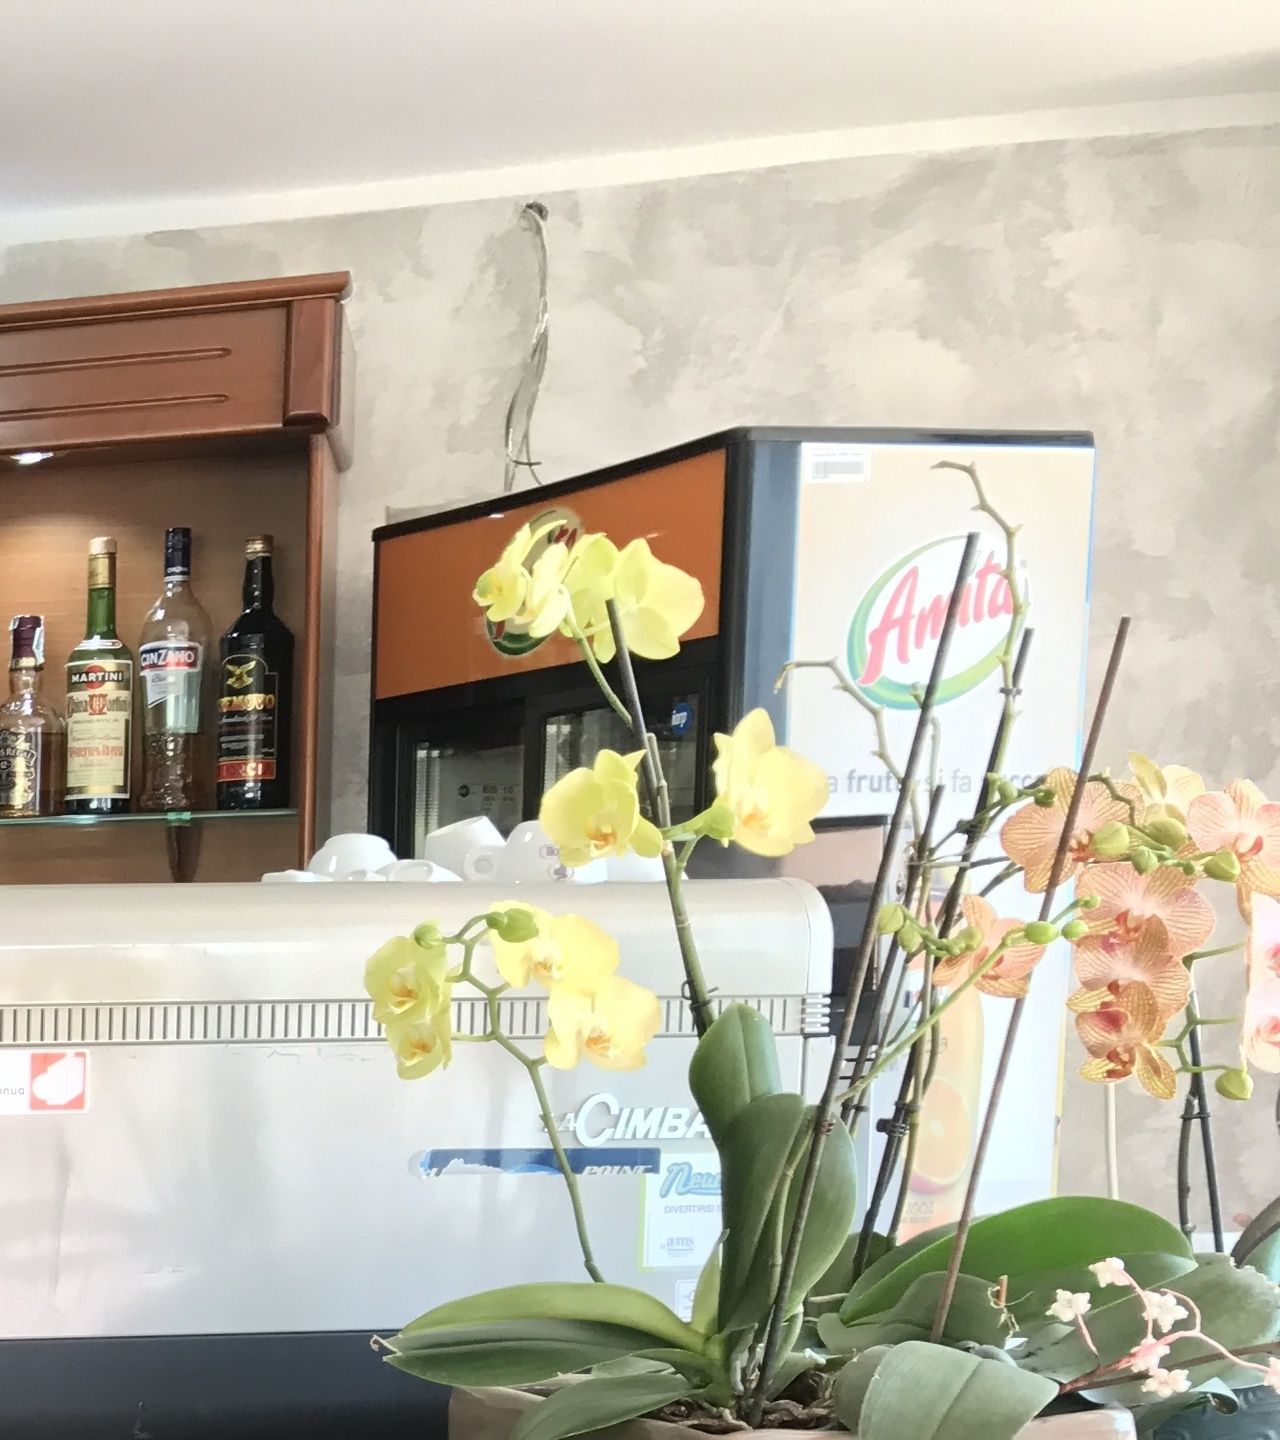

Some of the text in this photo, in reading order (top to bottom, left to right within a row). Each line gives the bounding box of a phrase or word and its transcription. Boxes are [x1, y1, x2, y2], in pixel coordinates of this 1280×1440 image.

[141, 649, 195, 667] CINZANO
[71, 672, 123, 683] MARTINI
[952, 768, 972, 793] fa
[575, 1092, 713, 1148] CIMBA
[663, 1204, 714, 1214] DIVERTIRSI
